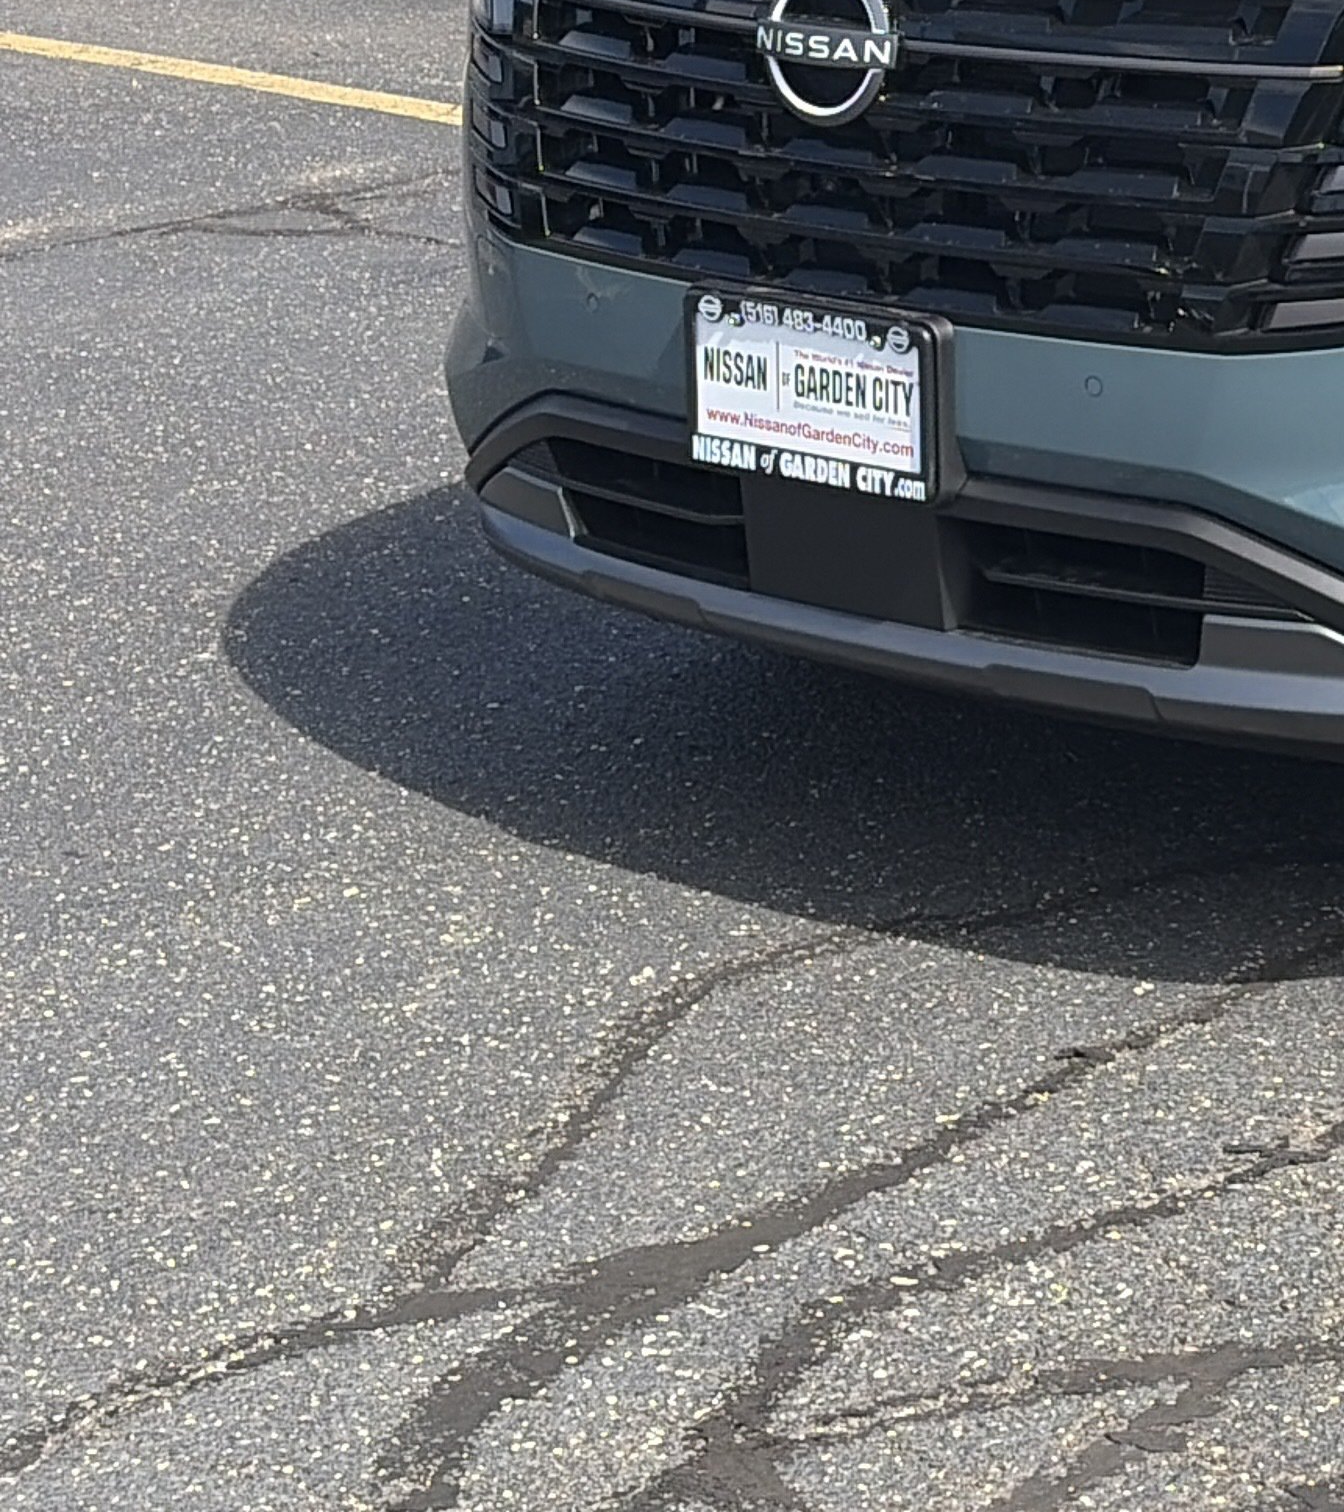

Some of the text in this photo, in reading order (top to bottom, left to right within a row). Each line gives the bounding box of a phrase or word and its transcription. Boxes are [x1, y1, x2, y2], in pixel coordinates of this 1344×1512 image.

[756, 25, 892, 65] NISSAN
[739, 300, 867, 341] (516) 483-4400
[704, 346, 768, 391] NISSAN
[794, 363, 867, 409] GARDEN
[872, 377, 914, 417] CITY
[706, 408, 914, 458] www.NissanofGardenCity.com
[692, 435, 926, 501] NISSAN of GARDEN CITY.com
